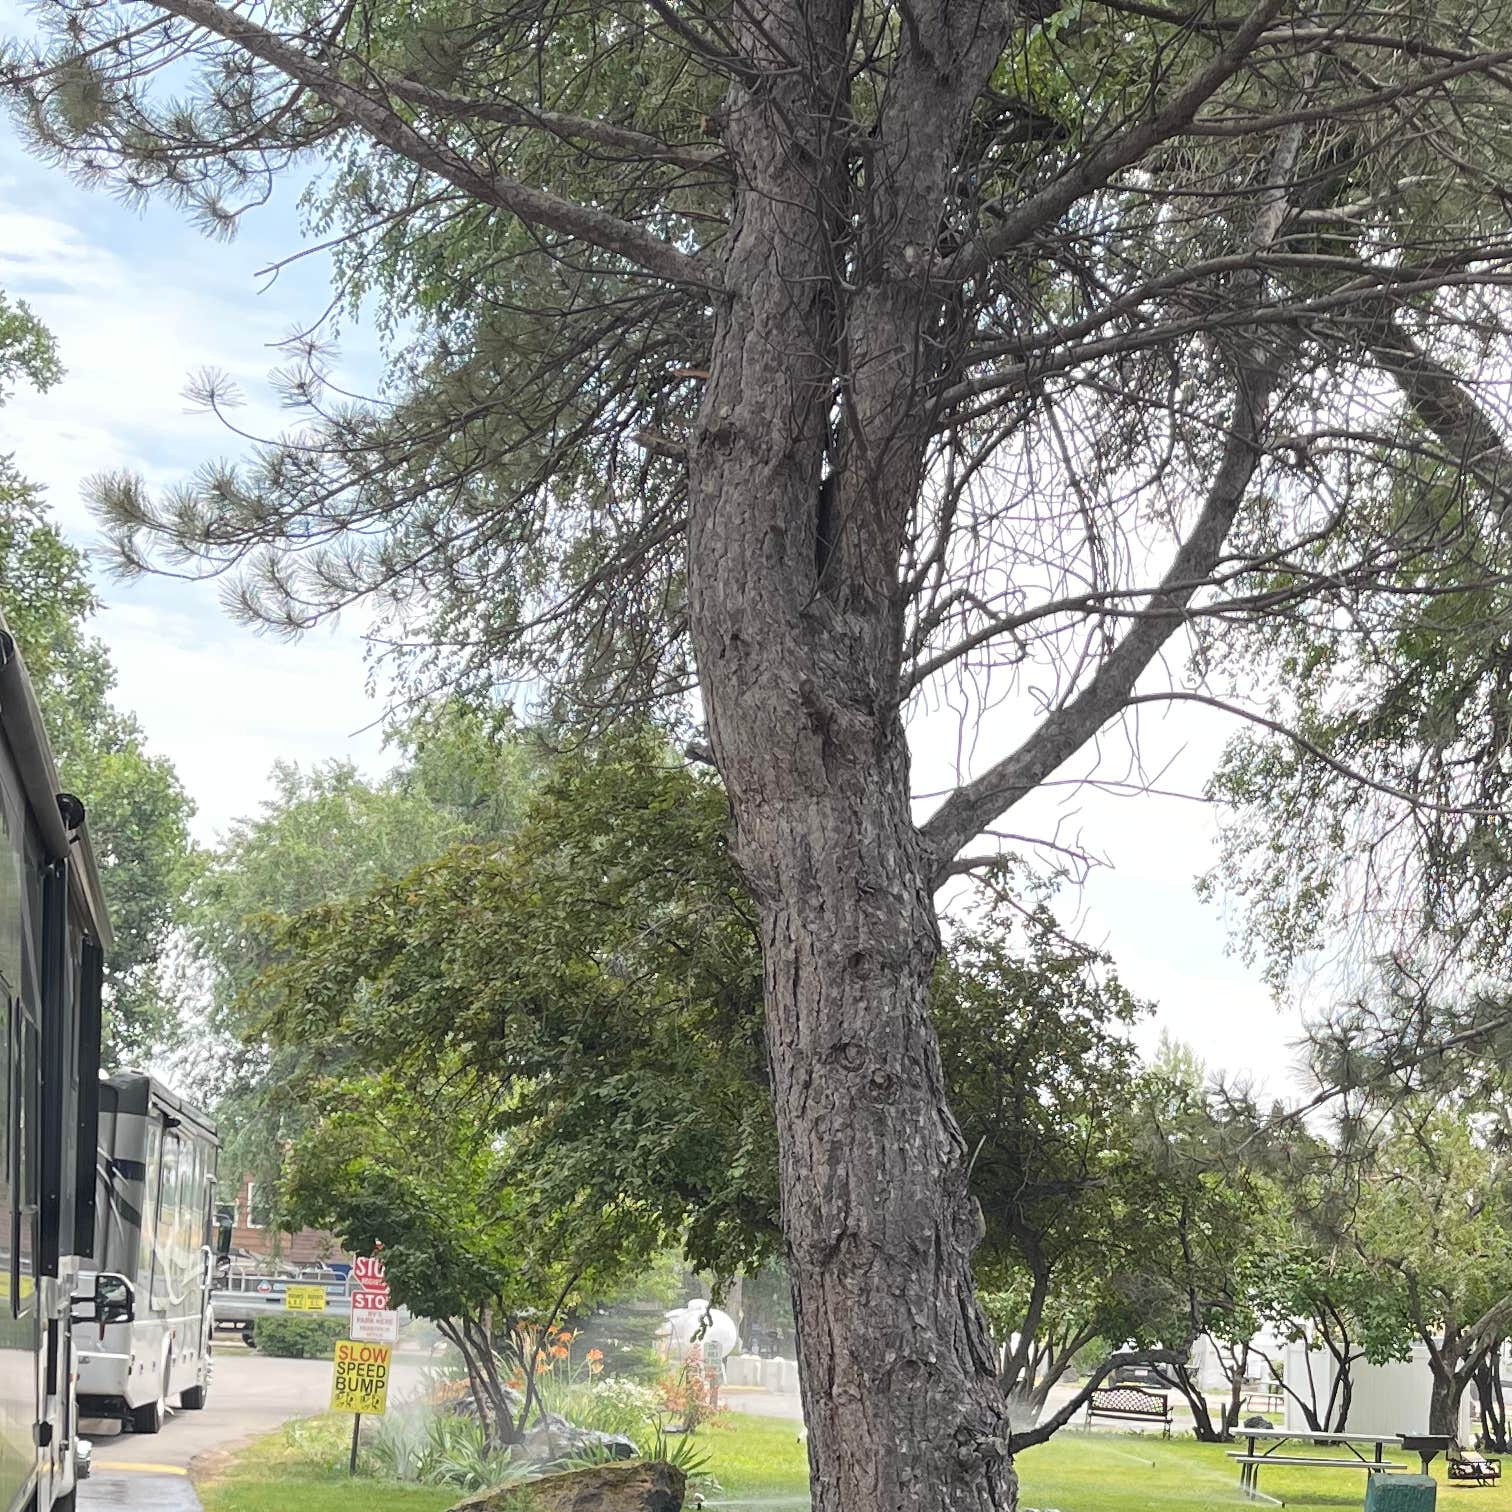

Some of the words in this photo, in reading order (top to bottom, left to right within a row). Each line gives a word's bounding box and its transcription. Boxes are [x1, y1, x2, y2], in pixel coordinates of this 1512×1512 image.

[355, 1256, 386, 1278] STO
[354, 1293, 391, 1309] STO
[338, 1344, 388, 1364] SLOW
[336, 1361, 386, 1378] SPEED
[335, 1376, 385, 1395] BUMP
